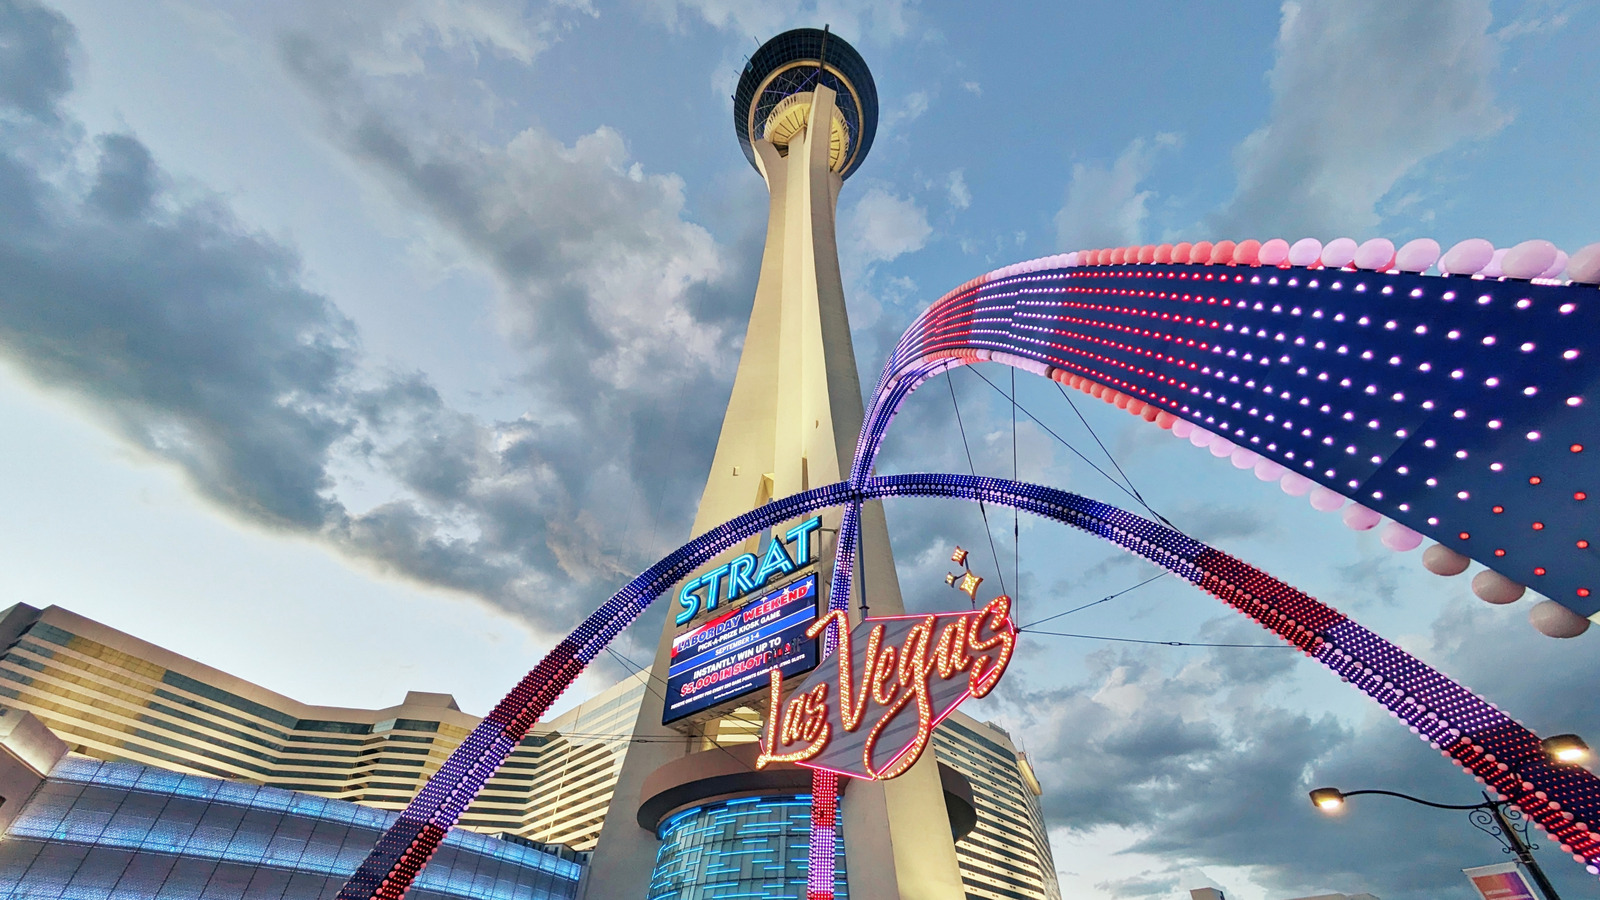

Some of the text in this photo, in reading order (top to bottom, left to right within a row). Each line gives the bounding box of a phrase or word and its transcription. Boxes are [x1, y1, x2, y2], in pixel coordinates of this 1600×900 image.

[676, 515, 822, 627] STRAT
[677, 586, 808, 652] LABOR DAY WEEKEND
[698, 610, 781, 652] PICK-A-PRIZE KIOSK GAME
[693, 654, 737, 680] INSTANTLY
[737, 646, 754, 662] WIN
[756, 641, 768, 654] UP
[769, 636, 781, 647] TO
[715, 636, 751, 656] SEPTEMBER
[750, 632, 760, 642] 1-4
[680, 673, 720, 697] $5,000
[719, 667, 733, 681] IN
[733, 655, 763, 676] SLOT
[756, 594, 1016, 781] Las Vegas
